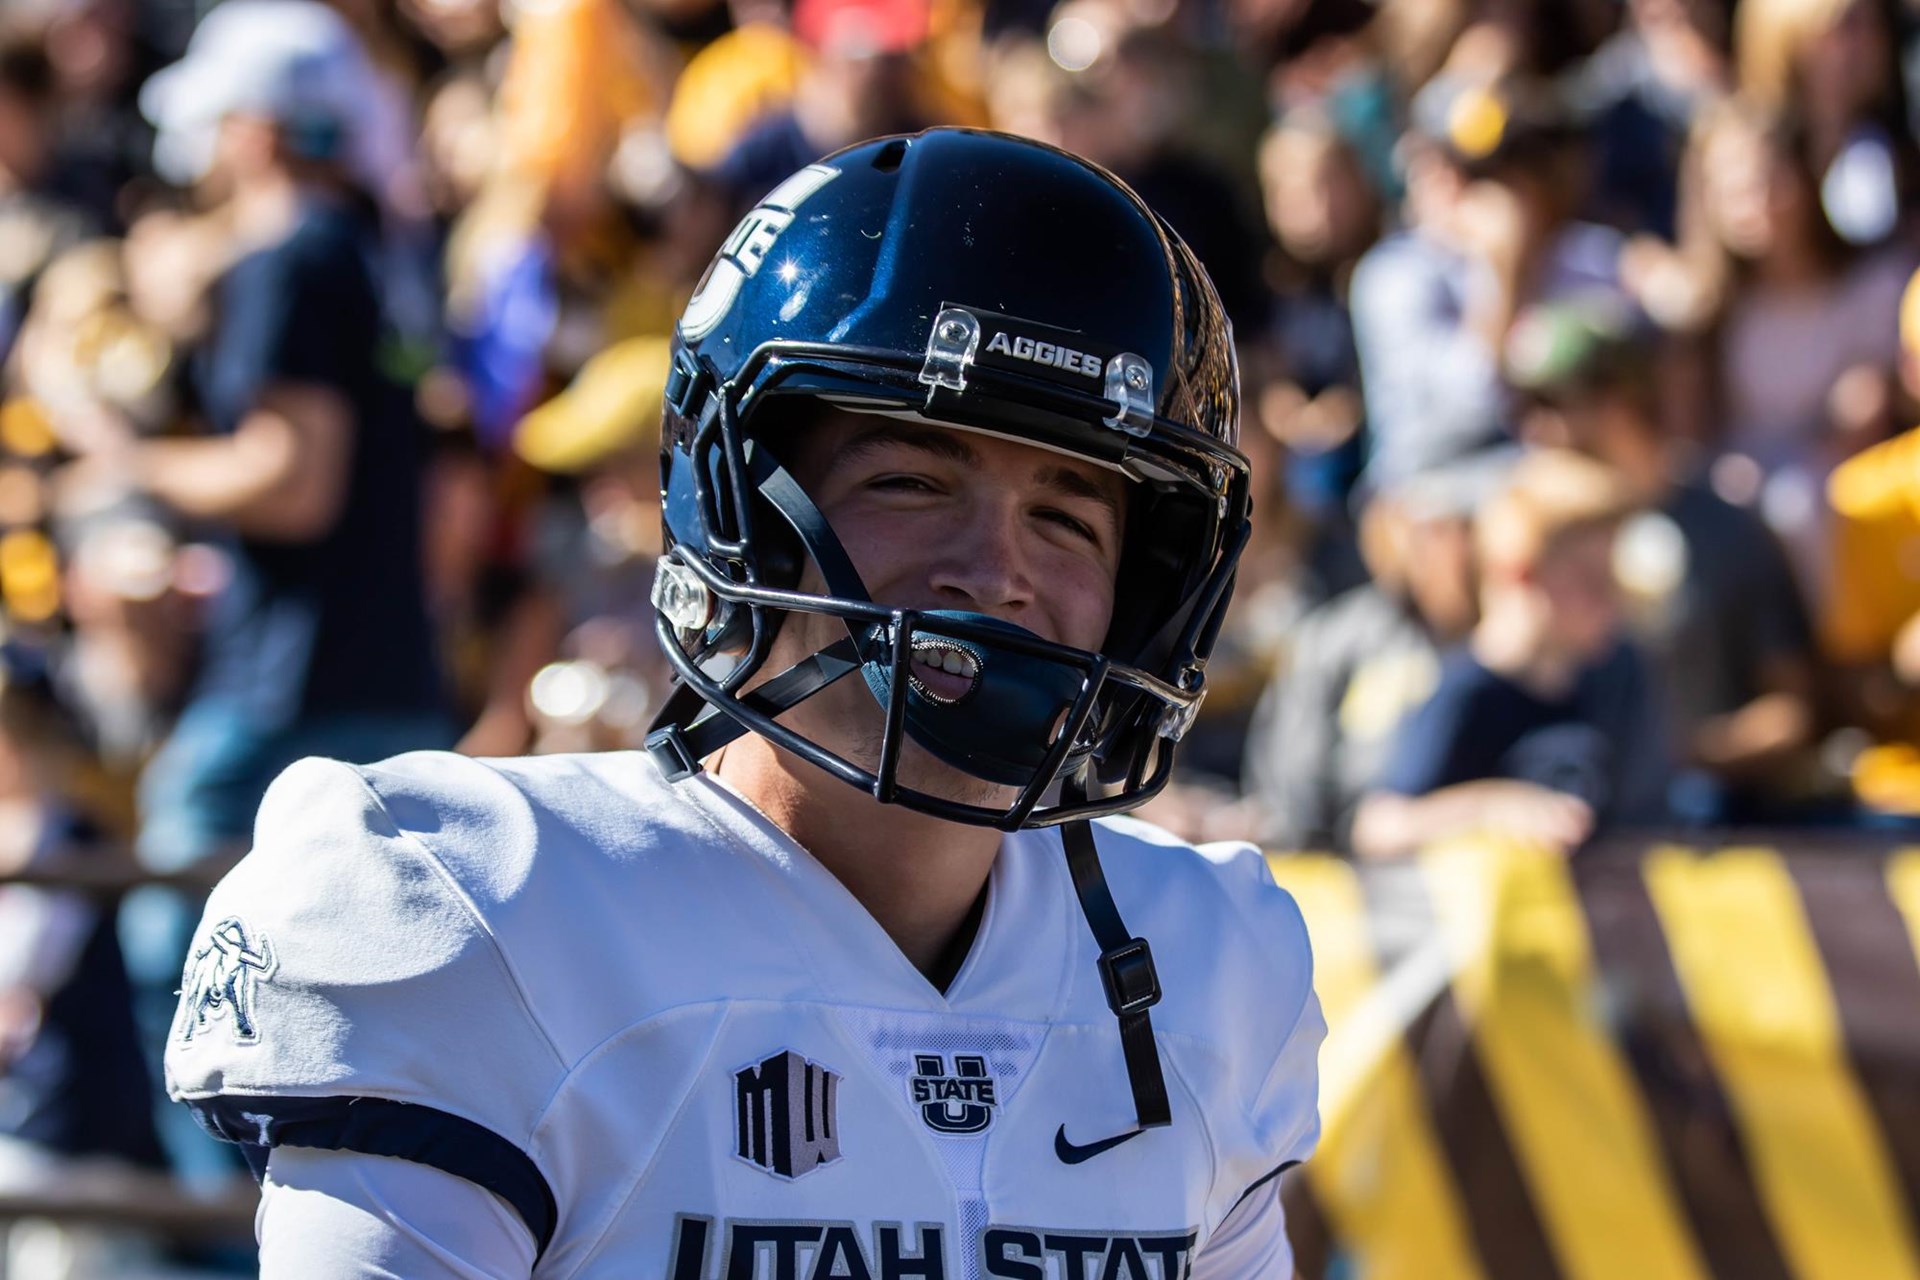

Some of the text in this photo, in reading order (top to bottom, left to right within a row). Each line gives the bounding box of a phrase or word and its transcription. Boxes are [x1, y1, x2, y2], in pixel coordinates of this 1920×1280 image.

[985, 331, 1102, 379] AGGIES
[735, 1049, 842, 1179] MW
[912, 1077, 997, 1106] STATE
[667, 1211, 945, 1280] UTAH
